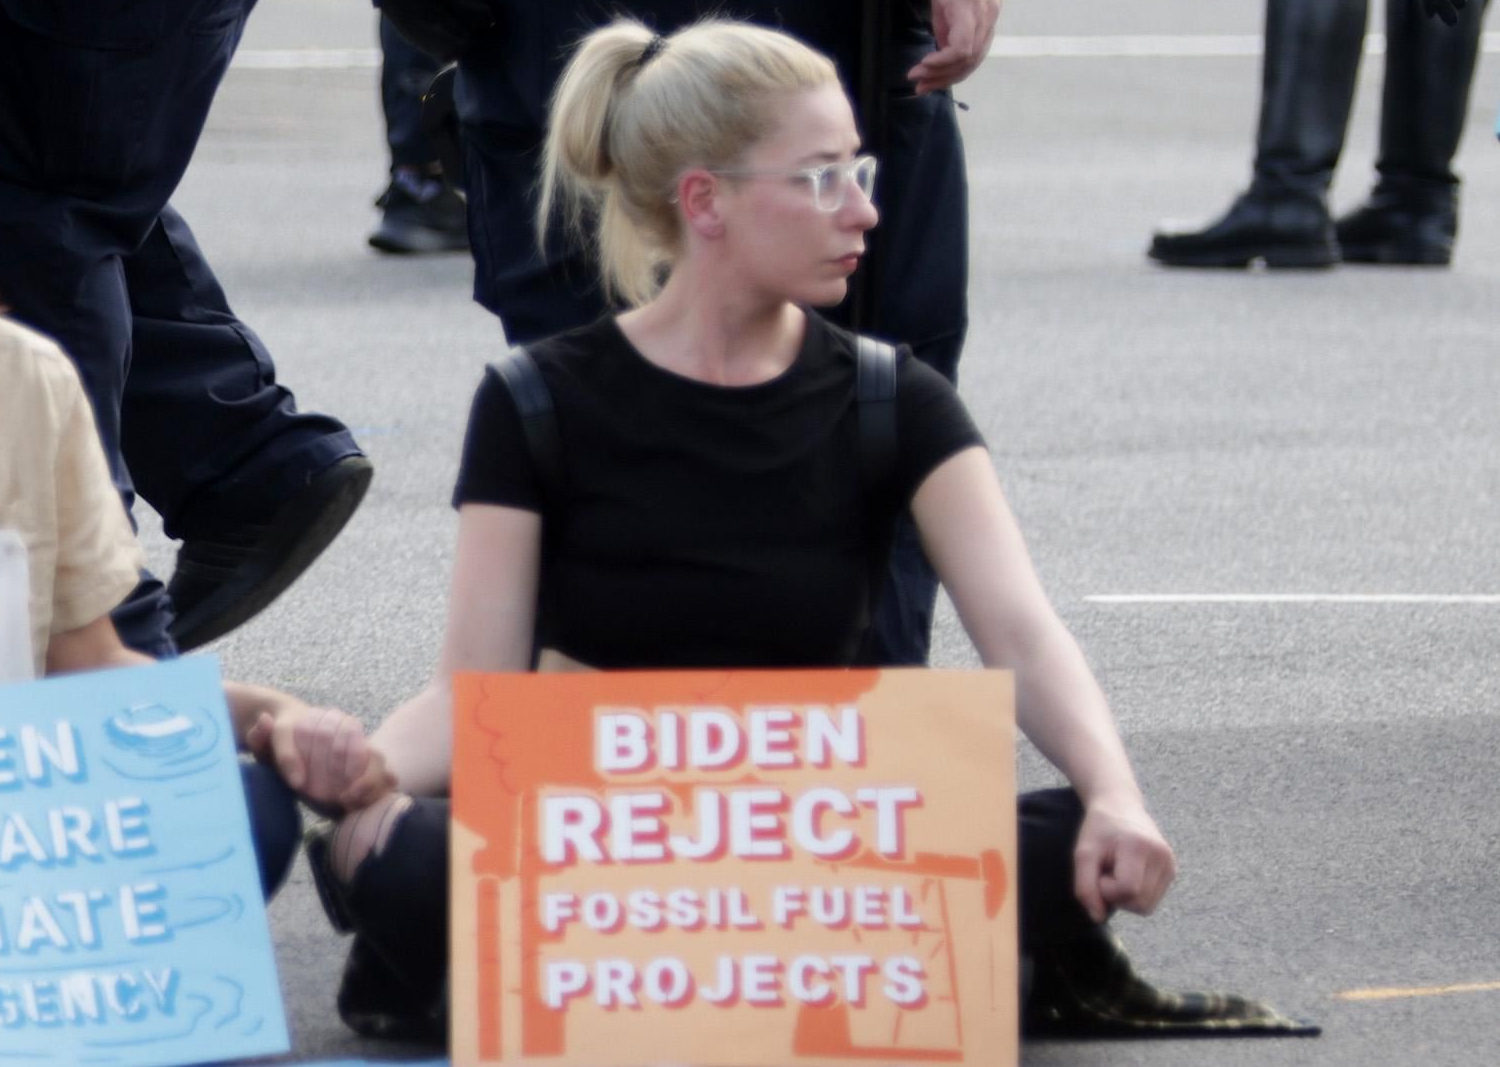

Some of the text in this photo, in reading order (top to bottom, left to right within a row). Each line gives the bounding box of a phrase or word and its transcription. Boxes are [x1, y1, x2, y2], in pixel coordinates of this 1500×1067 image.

[597, 706, 866, 773] BIDEN
[540, 786, 924, 867] REJECT
[543, 884, 926, 934] FOSSIL FUEL
[545, 954, 929, 1011] PROJECTS
